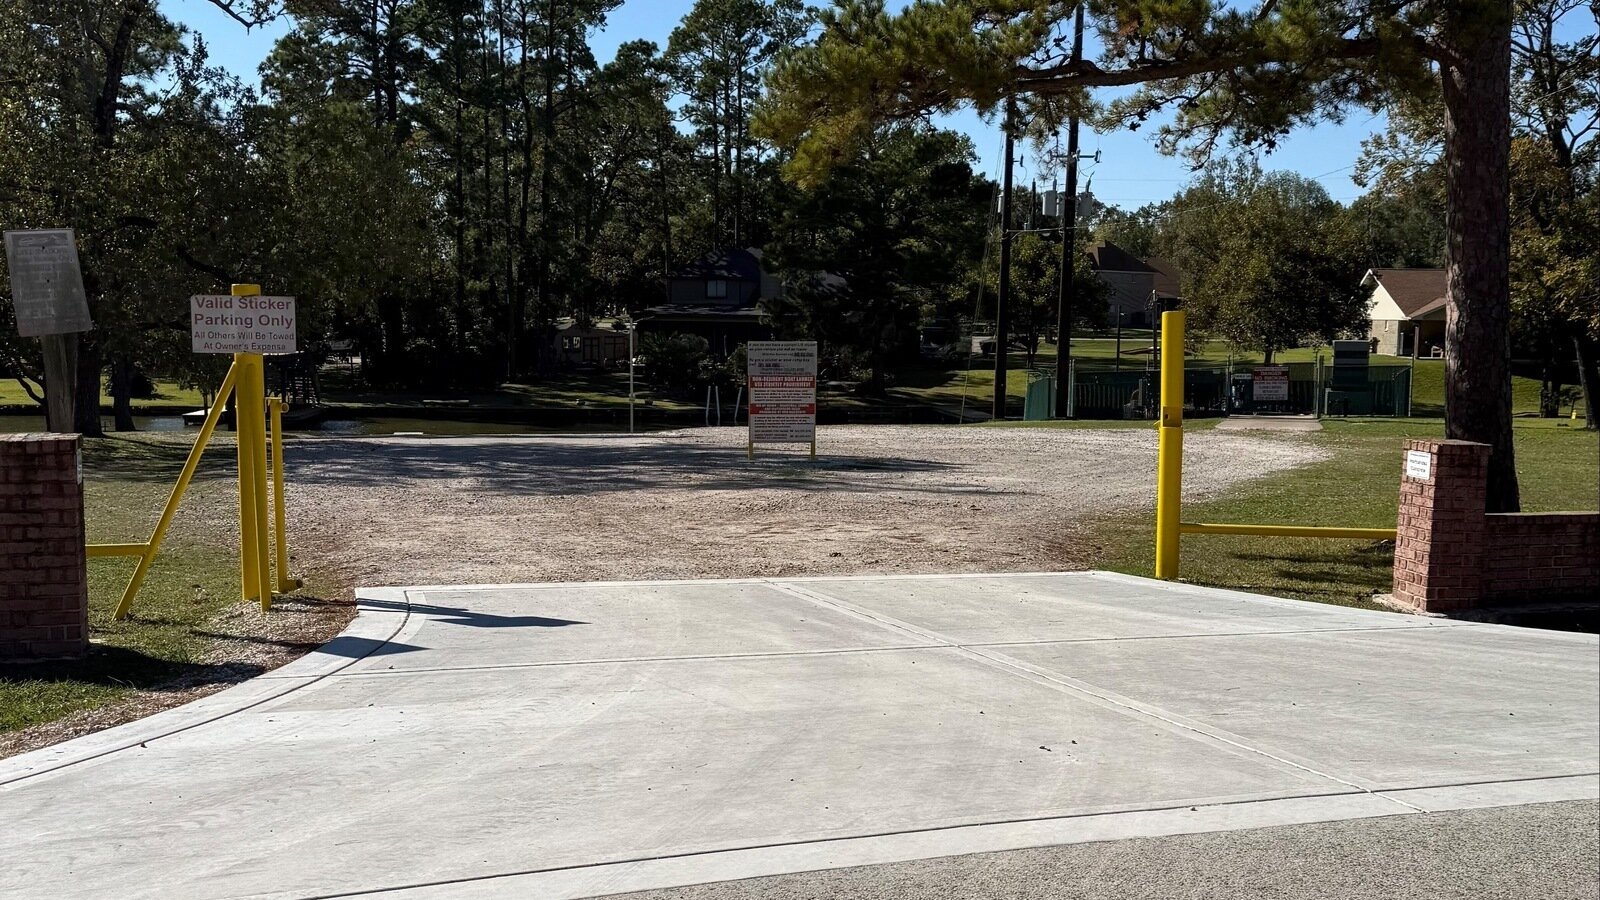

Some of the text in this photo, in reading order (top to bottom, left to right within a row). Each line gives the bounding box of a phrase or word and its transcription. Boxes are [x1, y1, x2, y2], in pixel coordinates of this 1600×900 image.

[195, 297, 292, 310] Valid Sticker
[194, 313, 293, 329] Parking Only
[194, 331, 295, 340] All Others Will Be Towed
[203, 342, 286, 351] At Owner's Expense
